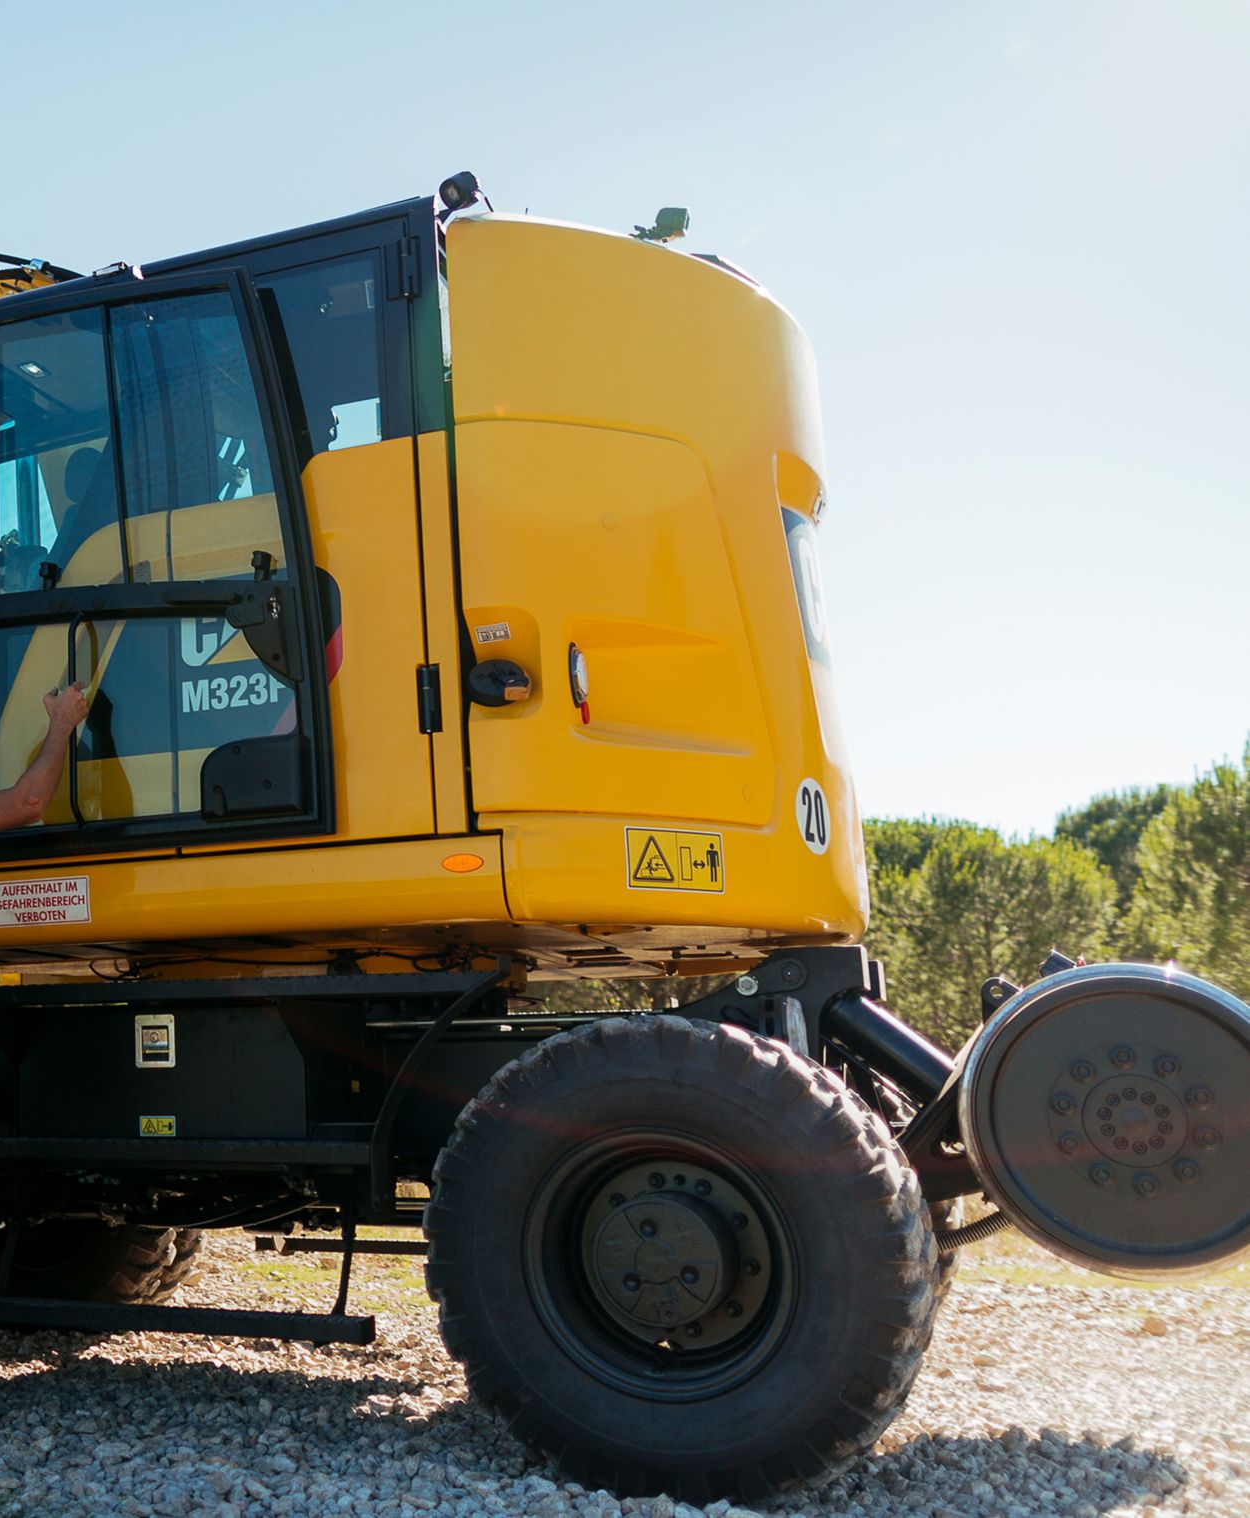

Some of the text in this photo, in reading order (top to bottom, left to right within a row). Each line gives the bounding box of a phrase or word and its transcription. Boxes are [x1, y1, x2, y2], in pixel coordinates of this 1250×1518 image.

[802, 786, 826, 846] 20
[1, 881, 78, 897] AUFENTHALT IM
[14, 910, 66, 922] VERBOTEN
